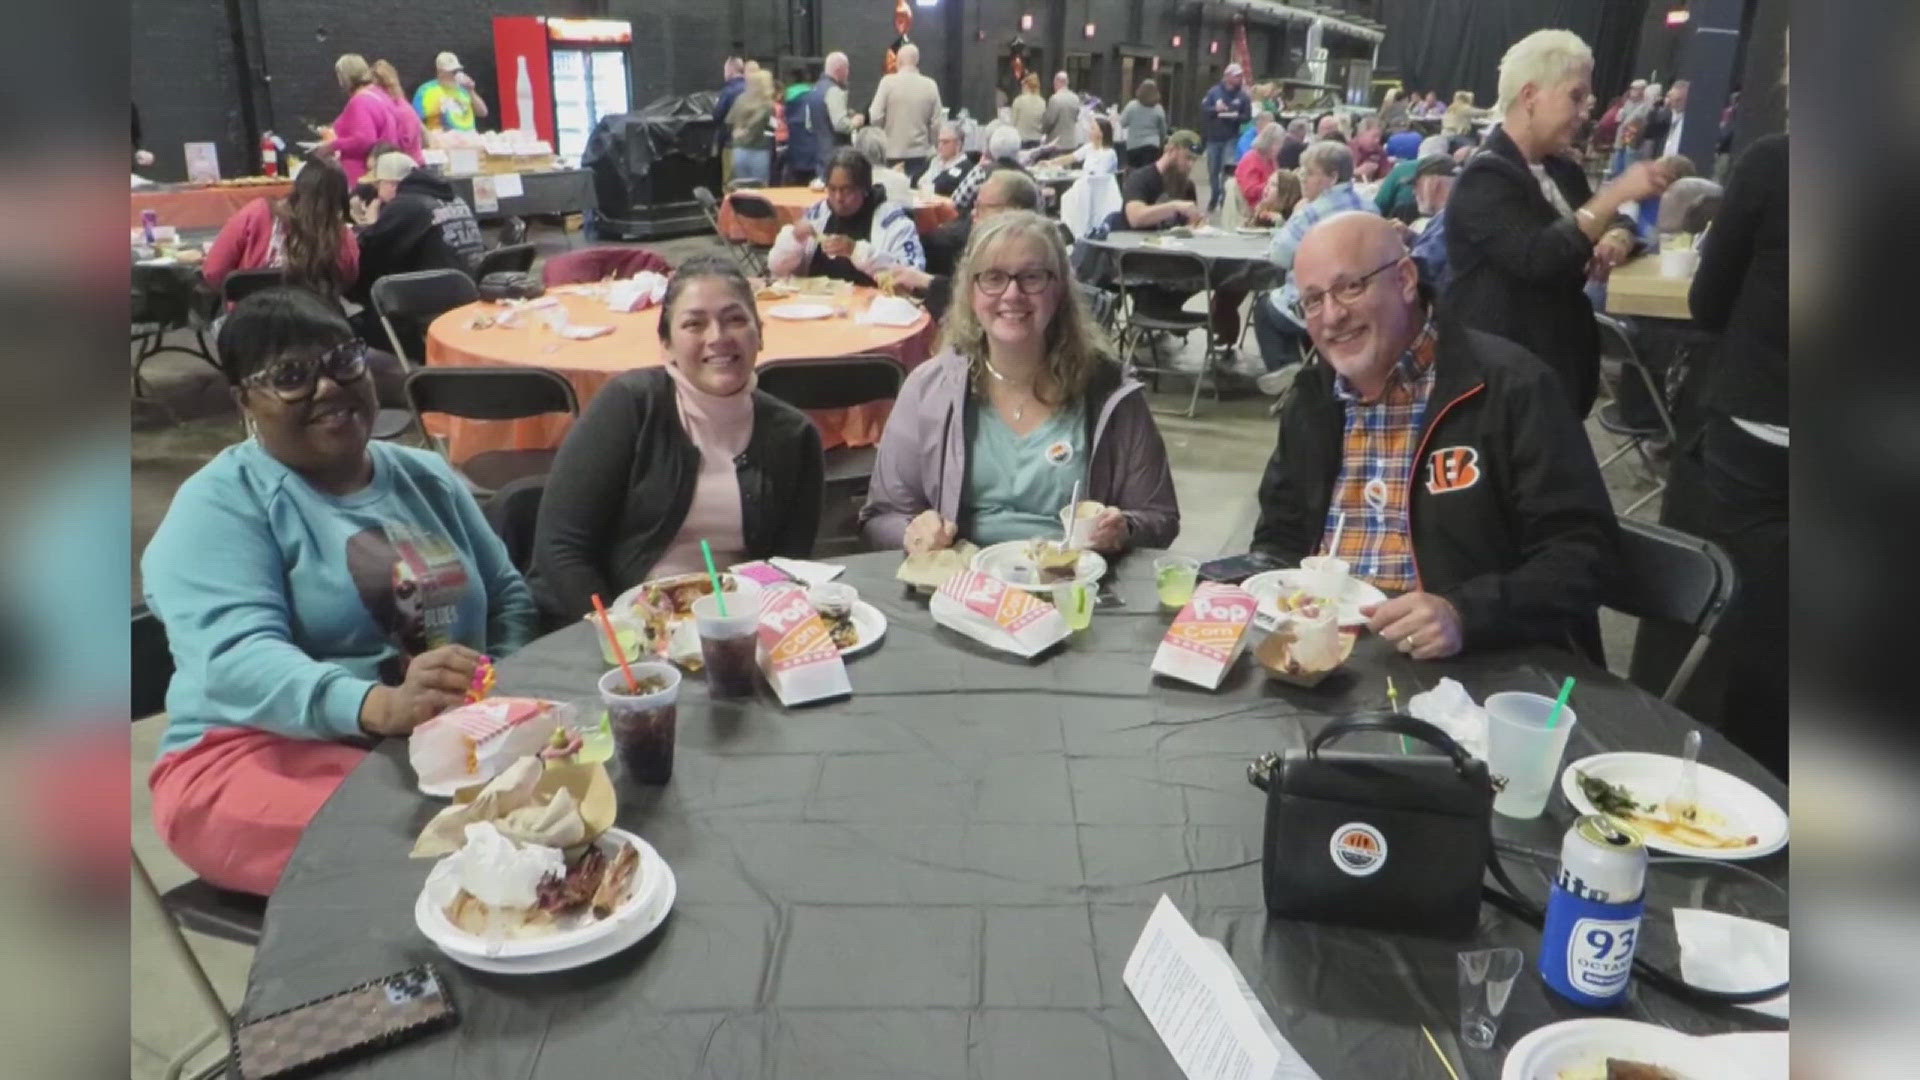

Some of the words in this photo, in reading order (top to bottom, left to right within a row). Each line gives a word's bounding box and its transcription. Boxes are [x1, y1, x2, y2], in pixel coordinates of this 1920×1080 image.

[761, 598, 811, 634] Pop
[1192, 597, 1248, 622] Pop
[1184, 624, 1235, 637] Corn
[1585, 927, 1635, 960] 93
[1577, 958, 1630, 971] OCTAN
